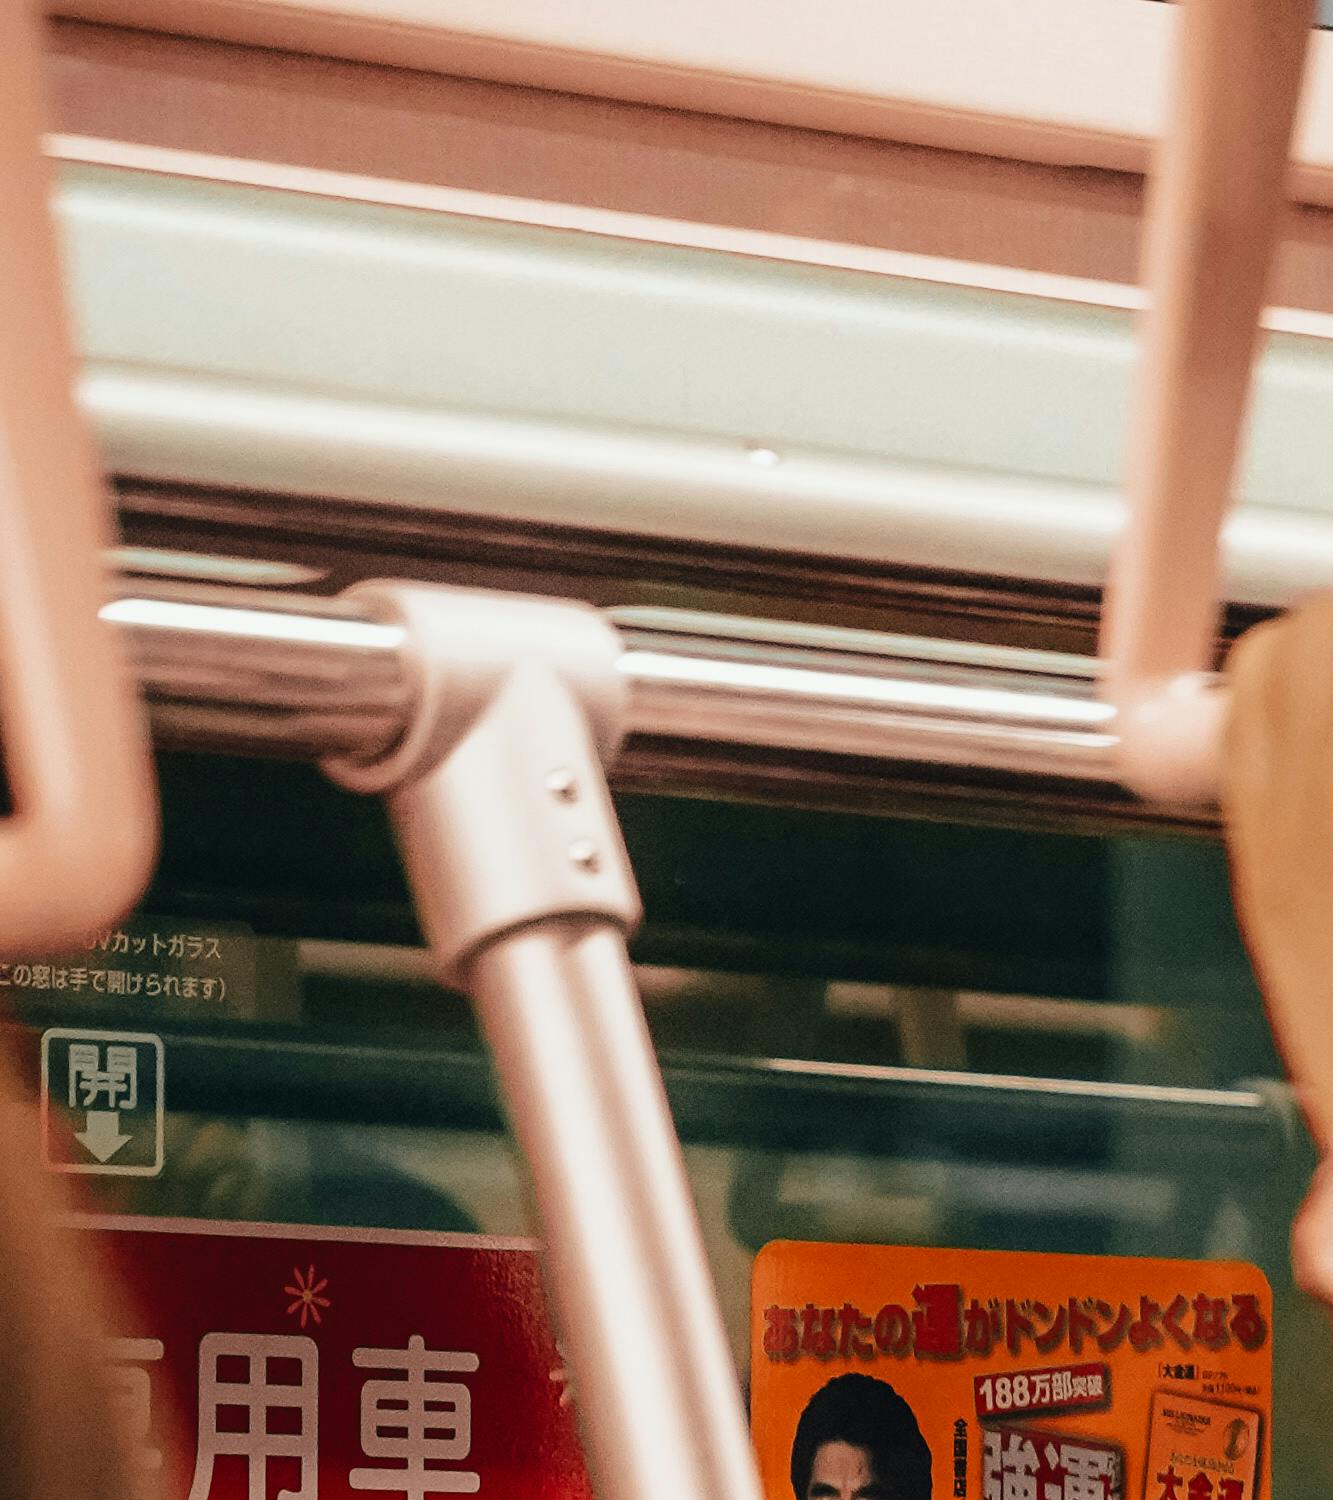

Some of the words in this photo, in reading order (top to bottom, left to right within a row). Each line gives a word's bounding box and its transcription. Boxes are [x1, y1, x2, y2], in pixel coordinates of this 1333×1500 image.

[88, 930, 222, 959] Vカットガラス
[68, 1044, 137, 1109] 開
[763, 1284, 1265, 1359] あなたの運がドンドンよくなる
